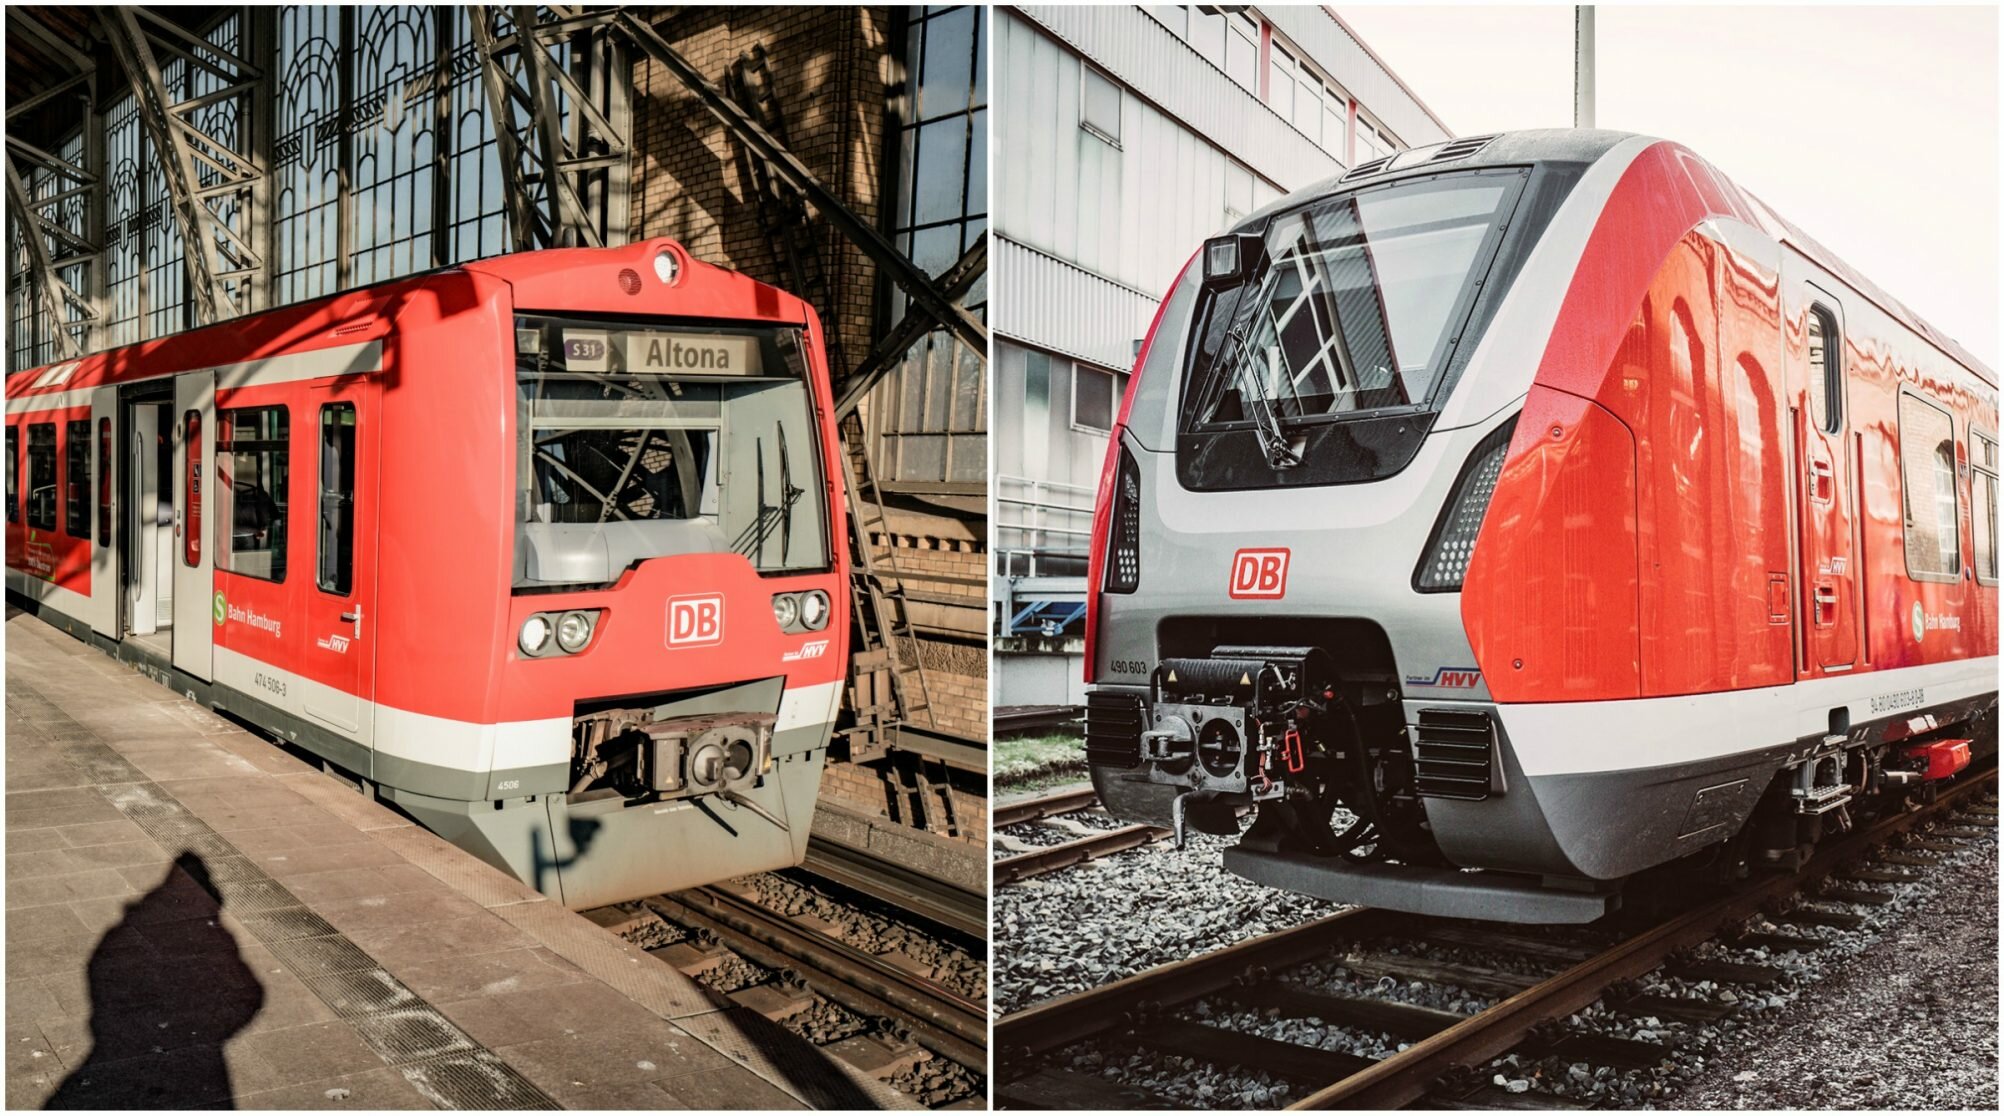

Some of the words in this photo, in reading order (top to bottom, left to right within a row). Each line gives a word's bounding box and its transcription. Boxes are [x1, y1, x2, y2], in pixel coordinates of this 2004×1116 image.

[573, 343, 581, 356] S
[582, 344, 596, 357] 31
[645, 338, 730, 369] Altona
[1236, 556, 1281, 590] DB
[215, 593, 225, 622] S
[227, 603, 246, 623] Bahn
[246, 608, 281, 639] Hamburg
[673, 602, 717, 640] DB
[1924, 612, 1938, 630] Bahn
[1938, 612, 1961, 633] Hamburg
[1110, 660, 1128, 674] 490
[1128, 660, 1147, 674] 603
[254, 671, 266, 688] 474
[267, 676, 287, 697] 506-3
[1440, 671, 1481, 688] HVV
[497, 779, 520, 790] 4506
